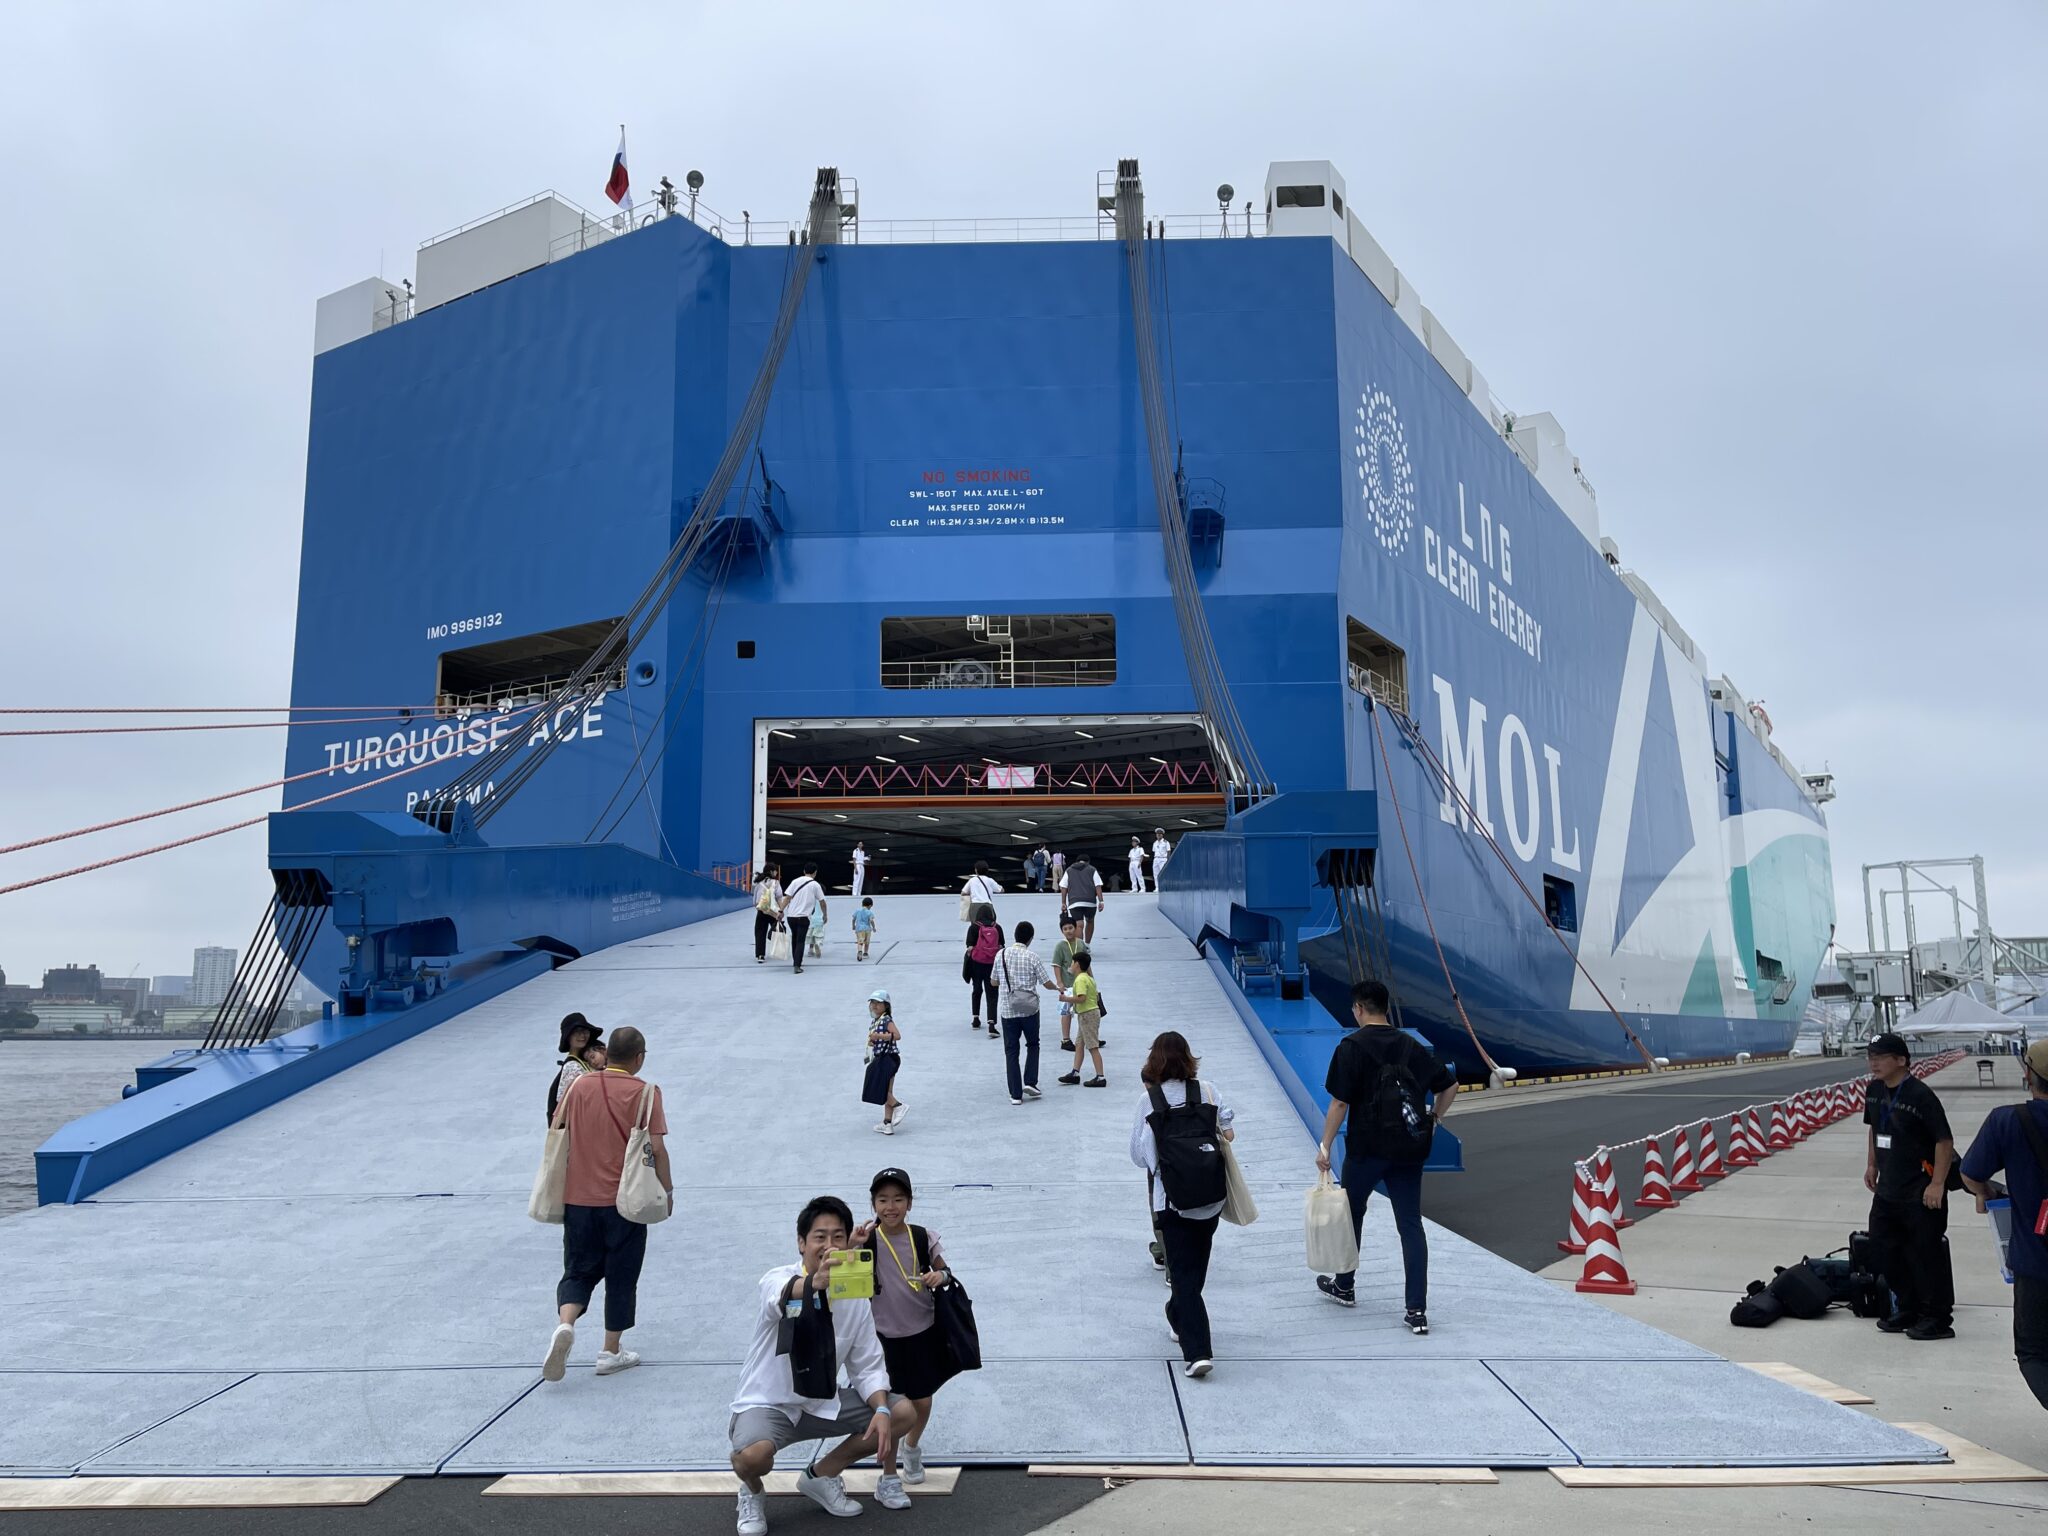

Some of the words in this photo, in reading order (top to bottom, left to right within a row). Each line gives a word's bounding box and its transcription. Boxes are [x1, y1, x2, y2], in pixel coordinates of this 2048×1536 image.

[923, 471, 945, 483] NO
[956, 469, 1031, 483] SMOKING
[987, 503, 1026, 511] 20KM/H
[890, 519, 920, 527] CLEAR
[1424, 524, 1481, 614] CLEAN
[1488, 581, 1542, 663] ENERGY
[427, 624, 448, 640] IMO
[450, 612, 503, 635] 9969132
[324, 716, 511, 776] TURQUOISE
[528, 691, 604, 747] ACE
[1432, 673, 1582, 873] MOL
